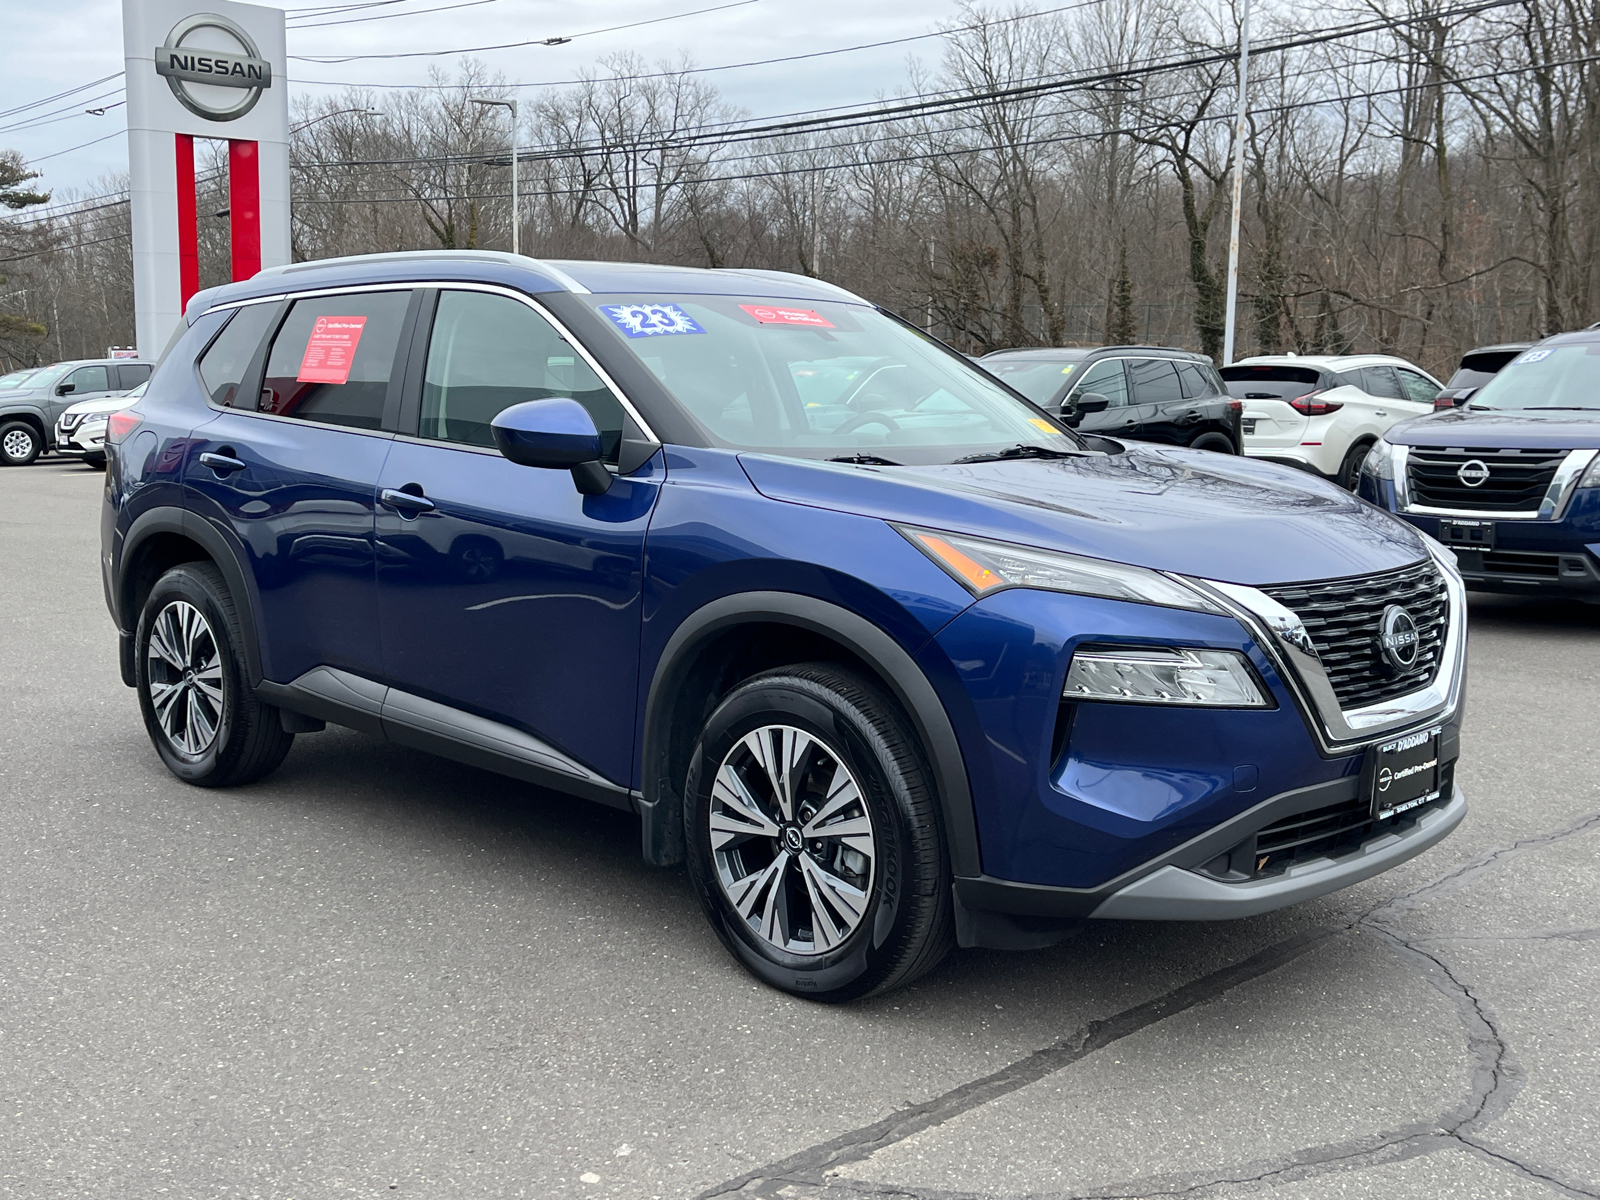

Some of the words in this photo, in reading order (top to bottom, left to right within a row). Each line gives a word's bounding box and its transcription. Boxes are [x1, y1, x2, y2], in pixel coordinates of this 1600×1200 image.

[169, 53, 262, 80] NISSAN
[630, 309, 675, 328] 23
[1397, 732, 1429, 752] D'ADDARIO
[1394, 766, 1414, 780] Certified
[1414, 758, 1438, 772] Pre-Owned
